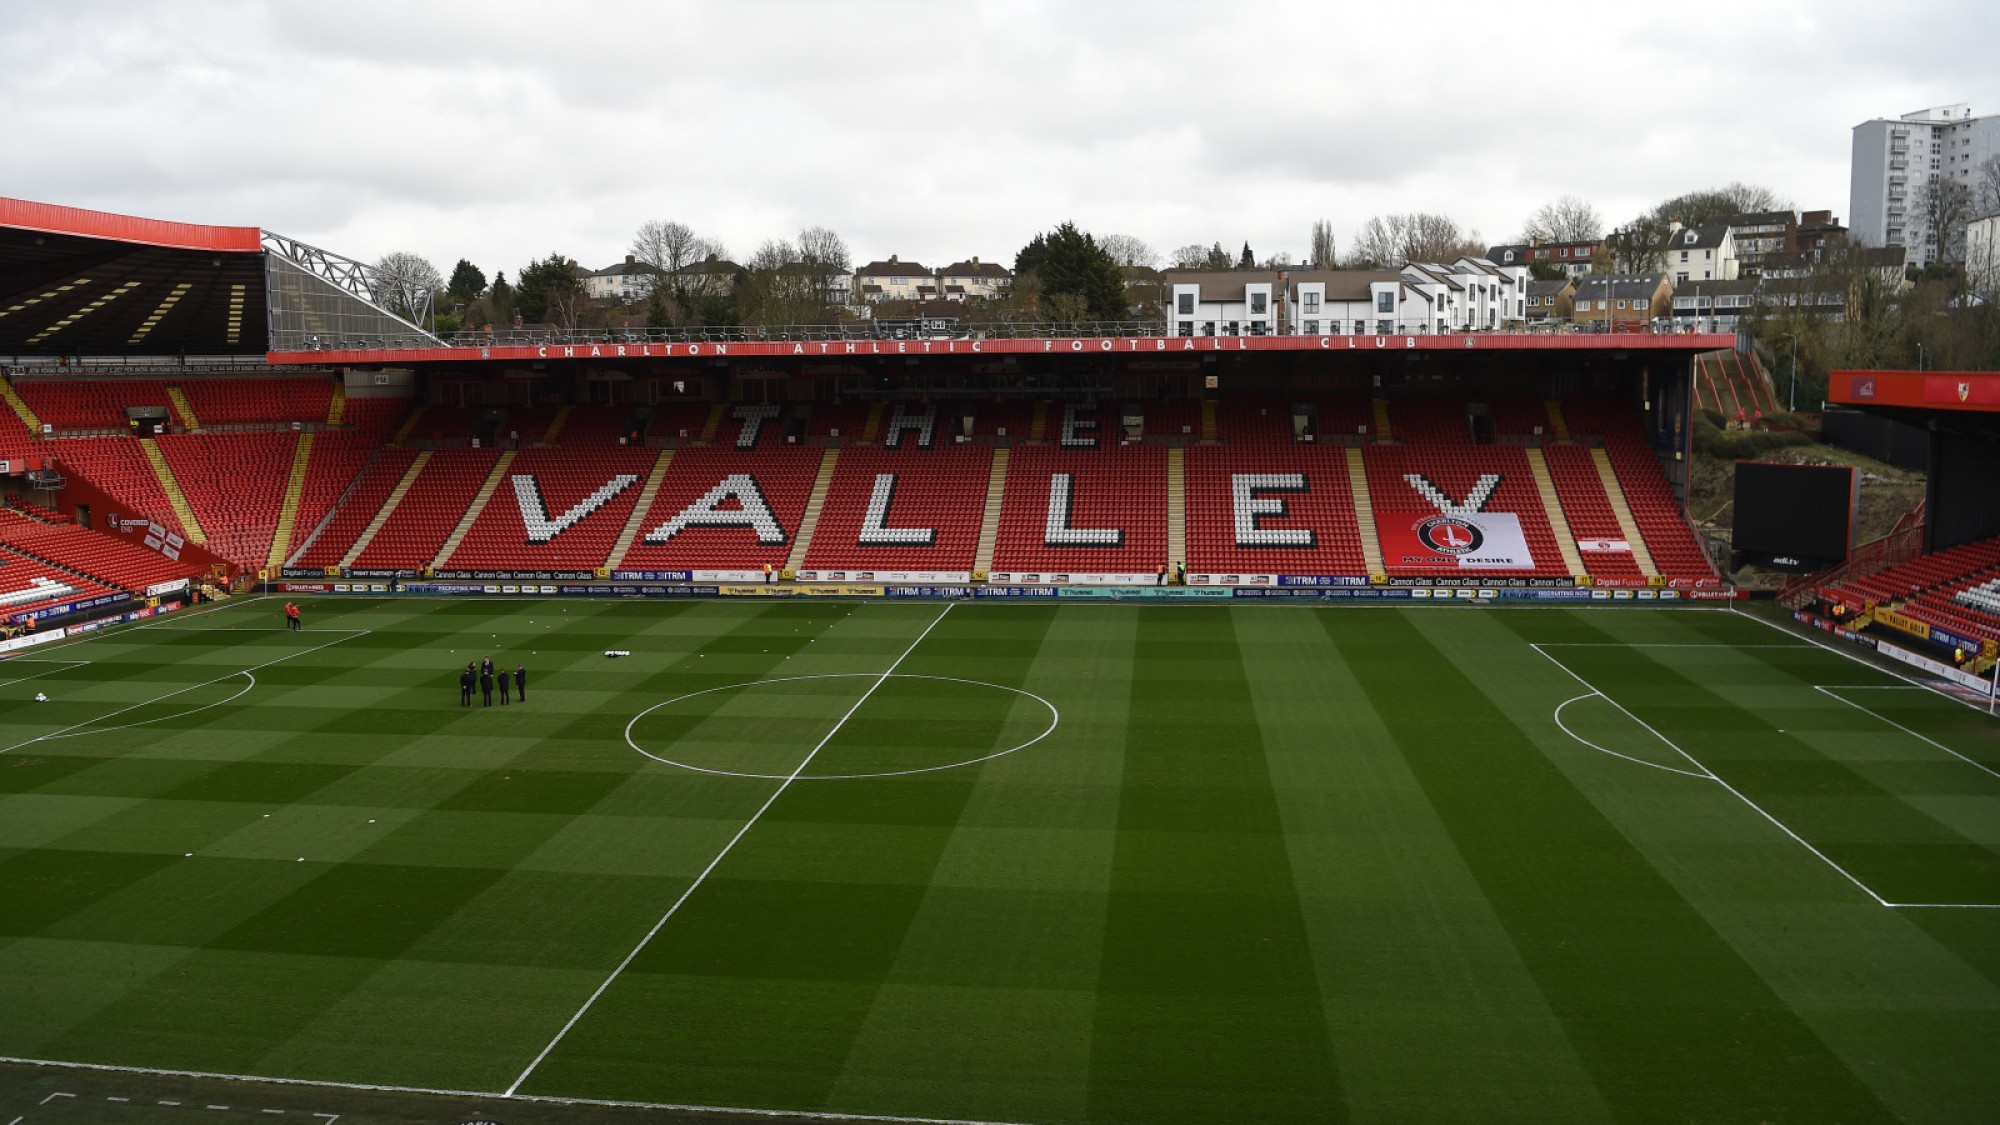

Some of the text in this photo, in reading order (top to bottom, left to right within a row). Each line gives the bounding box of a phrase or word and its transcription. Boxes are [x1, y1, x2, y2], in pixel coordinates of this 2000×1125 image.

[538, 336, 1416, 357] CHARLTON ATHLETIC FOOTBALL CLUB
[732, 404, 1097, 449] THE
[511, 474, 1505, 546] VALLEY
[283, 569, 302, 577] Digital
[434, 571, 471, 579] Cannon Glass
[474, 571, 511, 579] Cannon Glass
[514, 571, 551, 579] Cannon Glass
[554, 571, 592, 579] Cannon Glass
[621, 571, 642, 580] ITRM
[664, 571, 685, 580] ITRM
[1293, 576, 1317, 584] ITRM
[1342, 577, 1365, 585] ITRM
[1390, 578, 1432, 586] Cannon Glass
[1436, 578, 1479, 586] Cannon Glass
[1482, 578, 1525, 586] Cannon Glass
[1530, 578, 1573, 586] Cannon Glass
[1596, 578, 1620, 587] Digital
[897, 587, 919, 595] ITRM
[942, 587, 964, 595] ITRM
[986, 587, 1008, 595] ITRM
[1031, 587, 1053, 595] ITRM
[130, 611, 139, 621] sky
